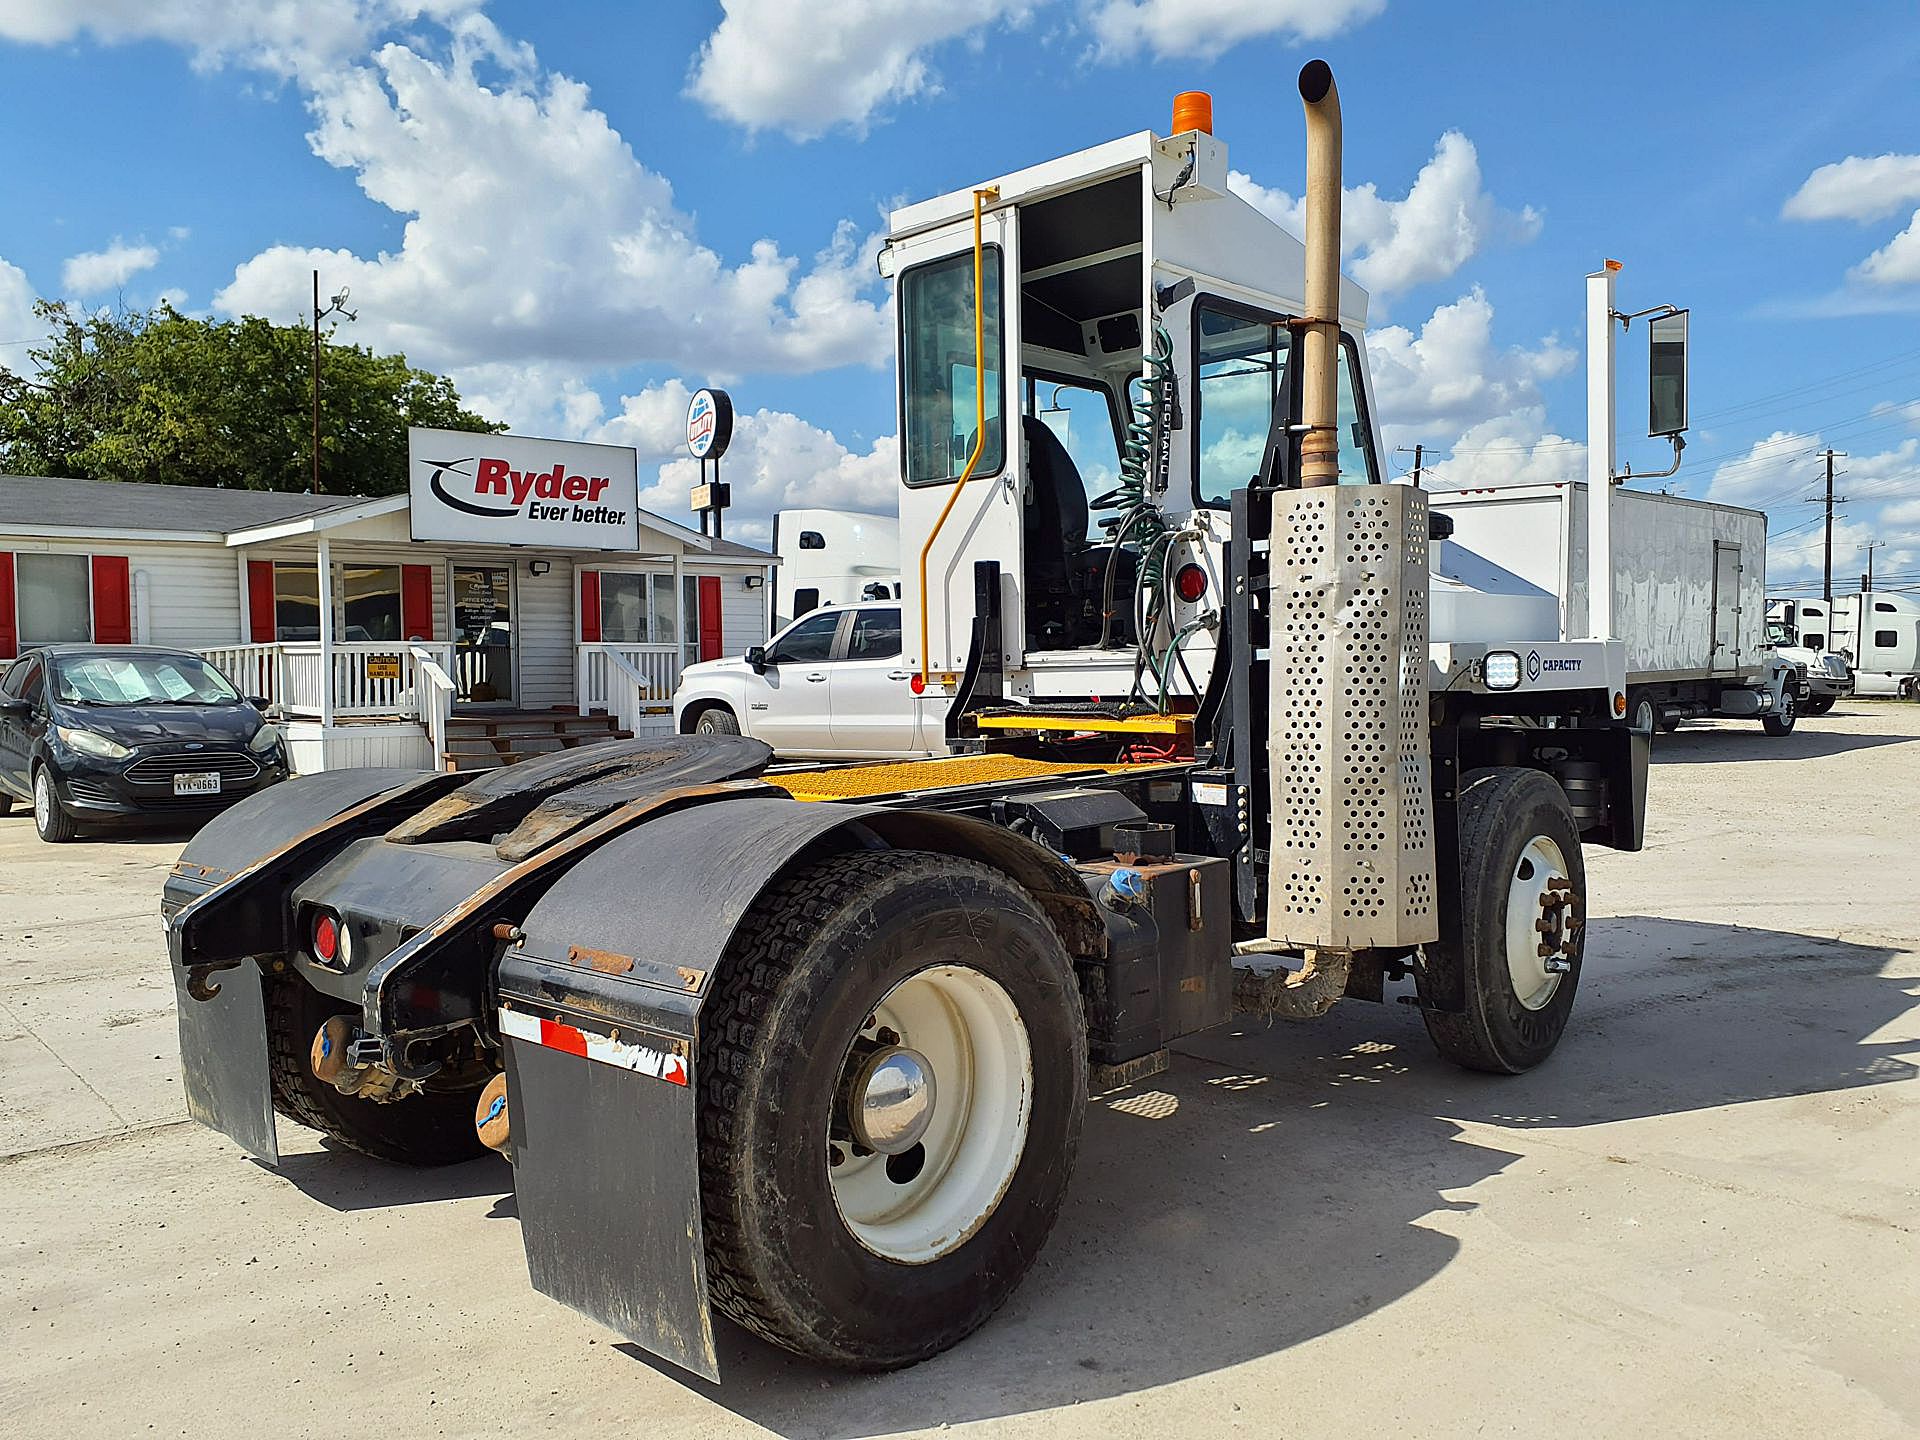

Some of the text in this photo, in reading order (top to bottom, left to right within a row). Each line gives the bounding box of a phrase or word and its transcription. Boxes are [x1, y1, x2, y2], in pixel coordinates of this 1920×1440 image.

[1161, 395, 1173, 460] TECTRAN
[475, 458, 610, 505] Ryder
[528, 501, 626, 526] Ever better.
[1542, 659, 1582, 671] CAPACITY
